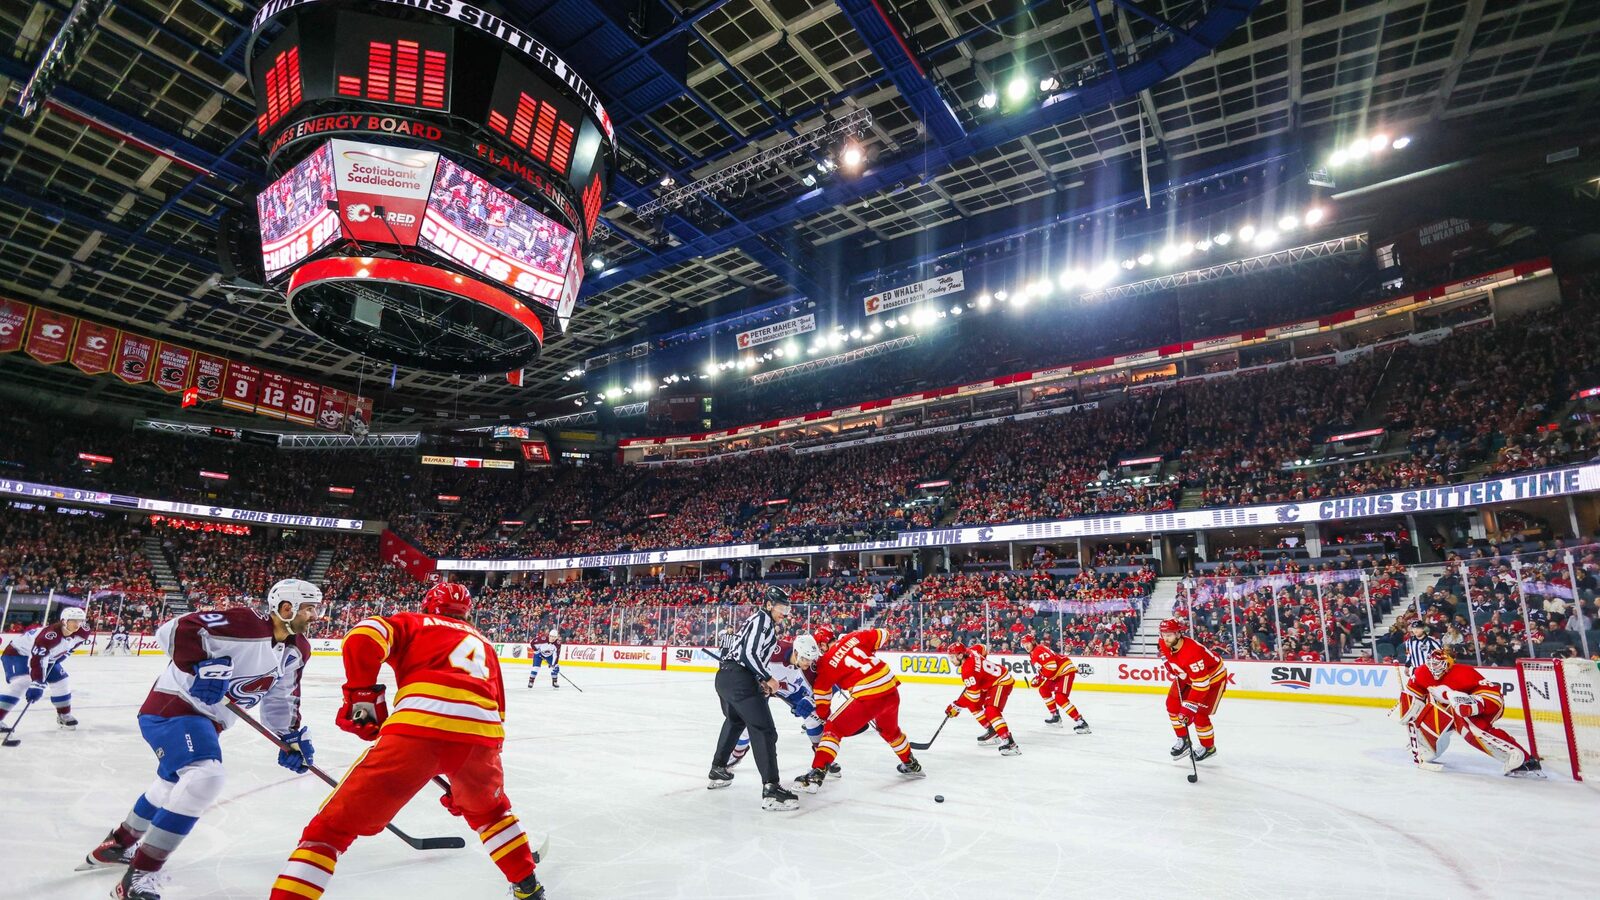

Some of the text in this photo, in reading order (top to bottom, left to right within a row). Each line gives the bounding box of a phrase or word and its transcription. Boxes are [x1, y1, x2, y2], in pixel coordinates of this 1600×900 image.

[458, 4, 559, 74] SUTTER
[562, 64, 599, 112] TIME
[297, 115, 363, 138] ENERGY
[367, 116, 442, 141] BOARD
[352, 163, 417, 179] Scotiabank
[477, 143, 543, 189] FLAMES
[347, 172, 421, 190] Saddledome
[386, 211, 416, 224] RED
[420, 217, 512, 282] CHRIS
[882, 292, 892, 301] ED
[893, 282, 924, 297] WHALEN
[750, 326, 772, 339] PETER
[772, 320, 797, 333] MAHER
[123, 344, 149, 362] WESTERN
[234, 380, 249, 398] 9
[262, 386, 285, 407] 12
[291, 394, 316, 414] 30
[15, 483, 24, 492] 0
[74, 491, 81, 499] 0
[1319, 469, 1580, 519] CHRIS SUTTER TIME
[231, 509, 340, 528] CHRIS SUTTER TIME
[931, 529, 963, 544] TIME
[578, 552, 651, 568] CHRIS SUTTER TIME
[453, 592, 460, 600] 4
[32, 645, 47, 656] 42
[448, 634, 490, 682] 4
[675, 649, 693, 659] SN
[828, 636, 861, 669] BACKLUND
[1038, 652, 1050, 661] 73
[844, 646, 881, 675] 11
[900, 655, 951, 675] PIZZA
[1188, 659, 1205, 673] 55
[203, 670, 232, 678] CC
[964, 676, 977, 688] 88
[1118, 663, 1236, 685] Scotiak
[1270, 666, 1388, 687] SN NOW
